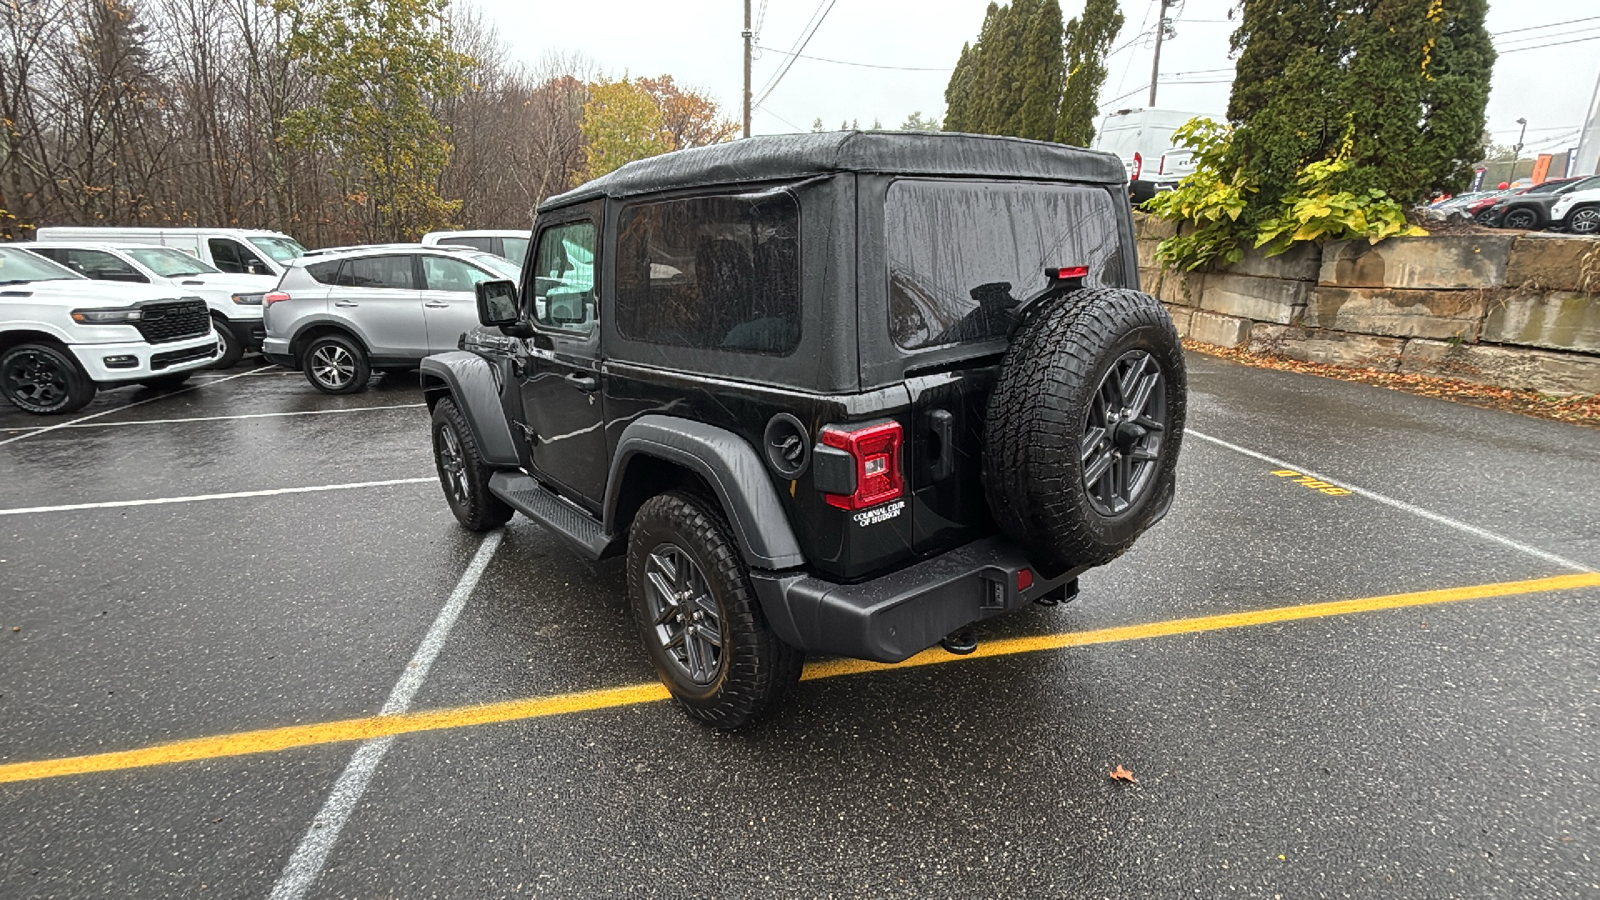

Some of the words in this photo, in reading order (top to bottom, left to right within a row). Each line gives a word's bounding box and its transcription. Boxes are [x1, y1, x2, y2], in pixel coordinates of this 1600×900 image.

[853, 507, 886, 521] COLONIAL
[859, 519, 871, 527] OF
[871, 509, 900, 523] HUDSON
